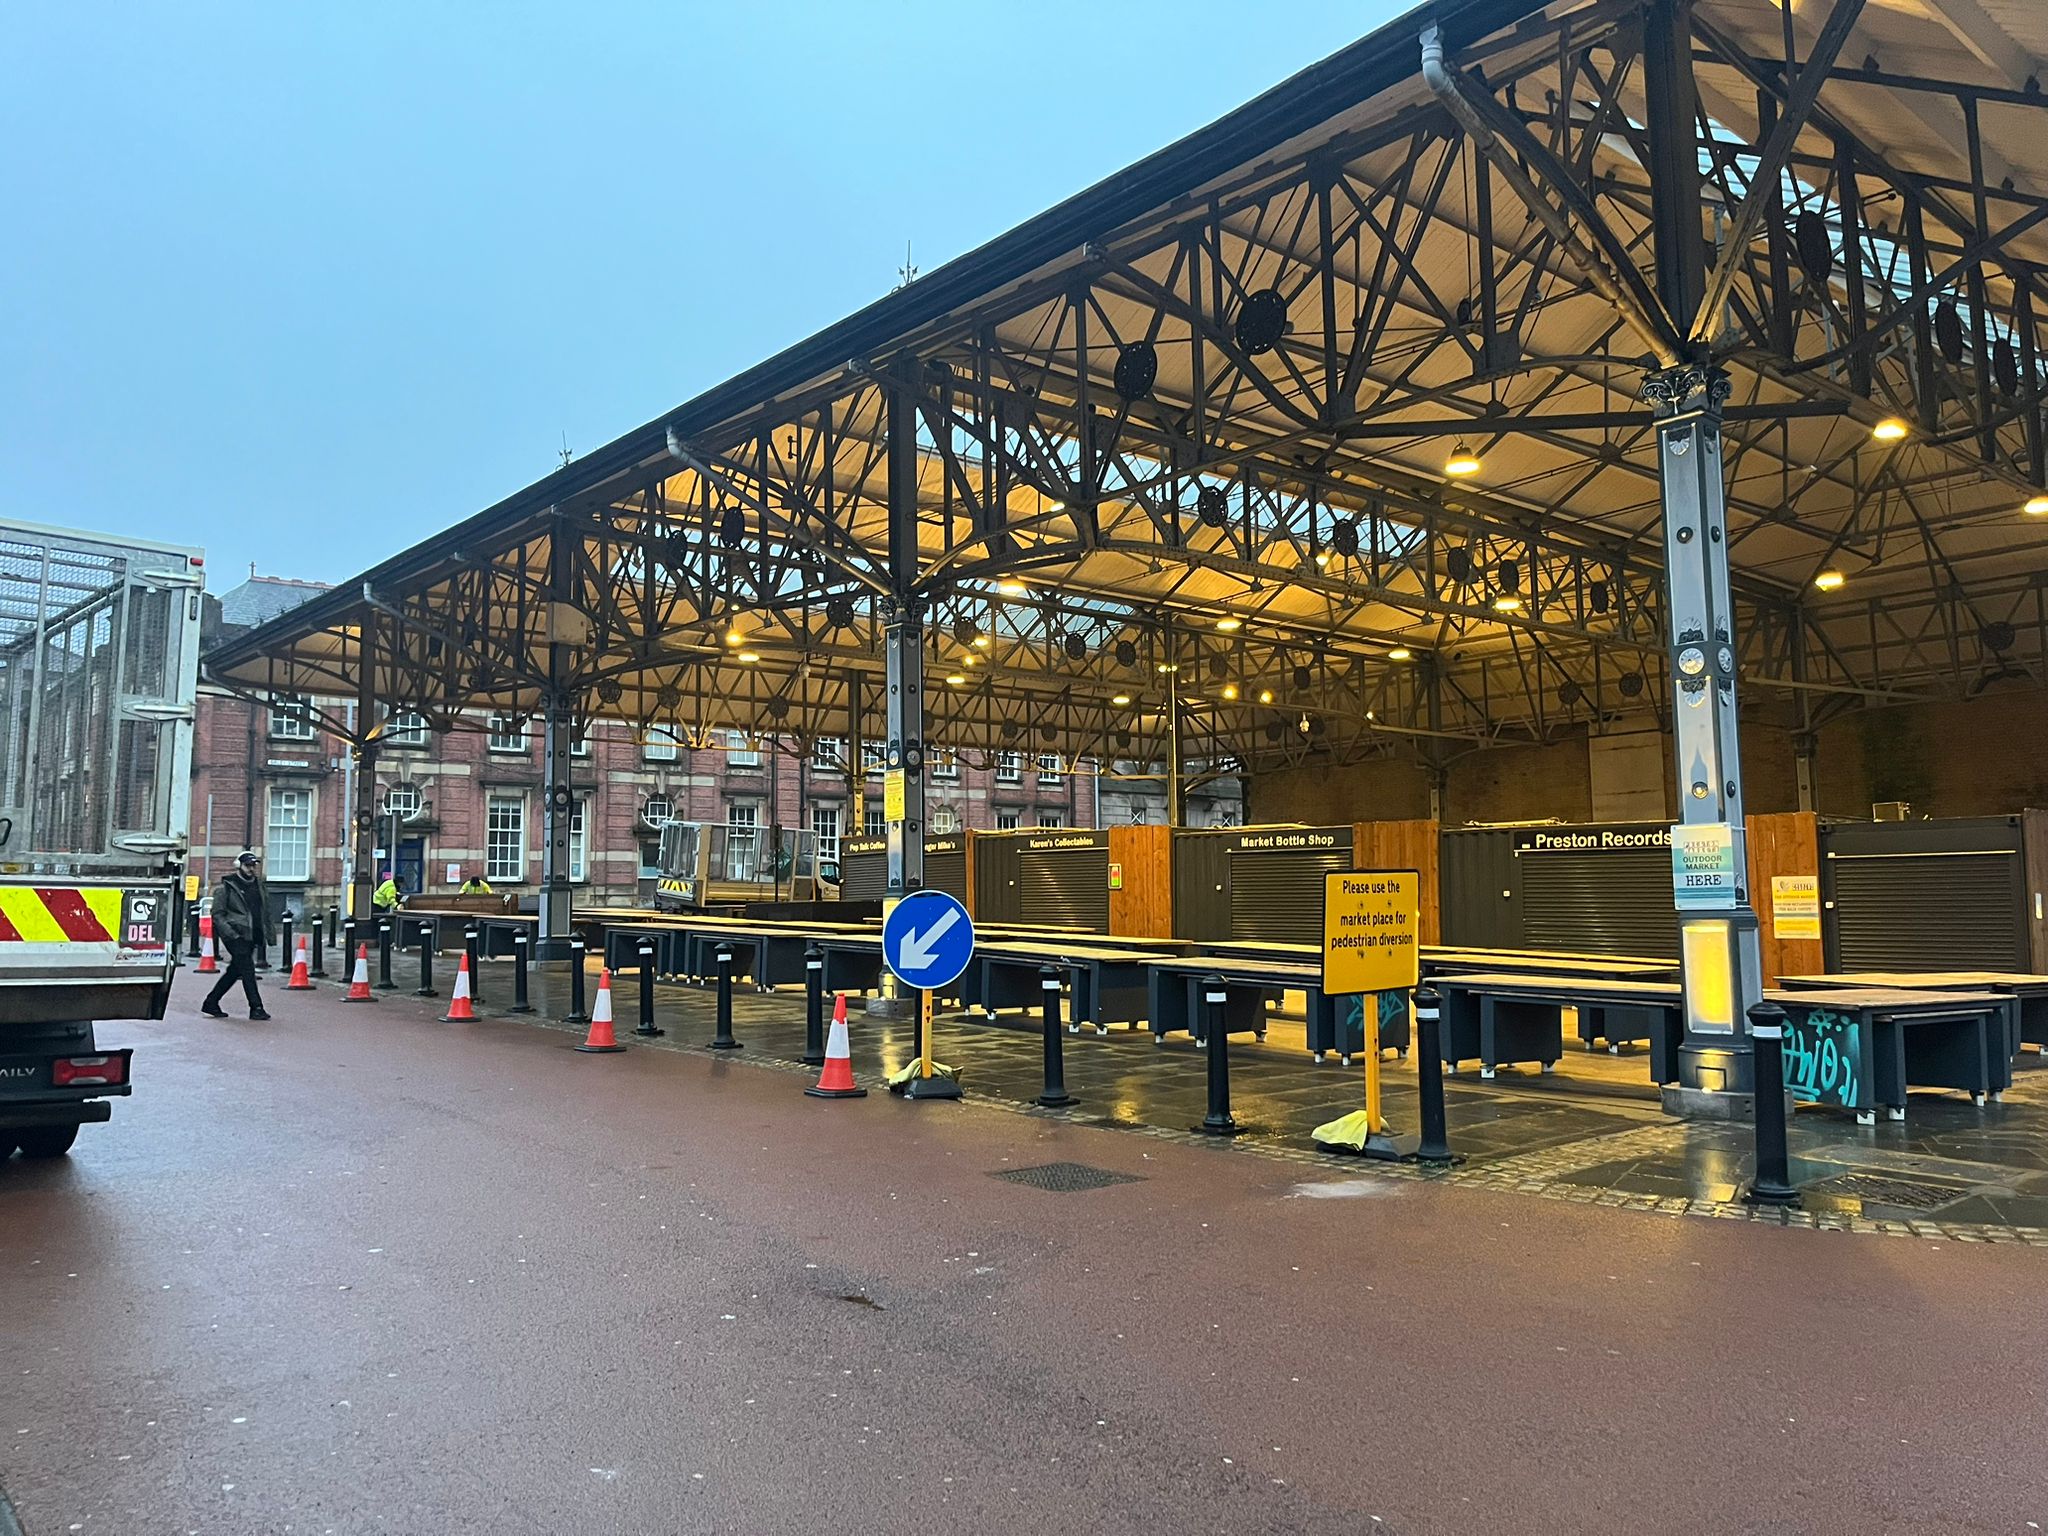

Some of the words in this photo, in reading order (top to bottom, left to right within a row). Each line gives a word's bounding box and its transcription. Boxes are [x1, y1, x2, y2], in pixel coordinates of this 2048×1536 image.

[1029, 838, 1053, 848] Karen's
[1054, 836, 1094, 847] Collectables
[1240, 836, 1274, 848] Market
[1275, 834, 1306, 846] Bottle
[1308, 834, 1334, 847] Shop
[1535, 832, 1597, 849] Preston
[1602, 829, 1672, 847] Records
[1683, 855, 1722, 863] OUTDOOR
[1342, 880, 1370, 894] Please
[1371, 883, 1386, 894] use
[1387, 880, 1400, 894] the
[1686, 874, 1722, 886] HERE
[1340, 911, 1371, 926] market
[1372, 911, 1394, 928] place
[1395, 910, 1407, 924] for
[127, 924, 156, 942] DEL
[1331, 932, 1377, 951] pedestrian
[1379, 931, 1413, 946] diversion
